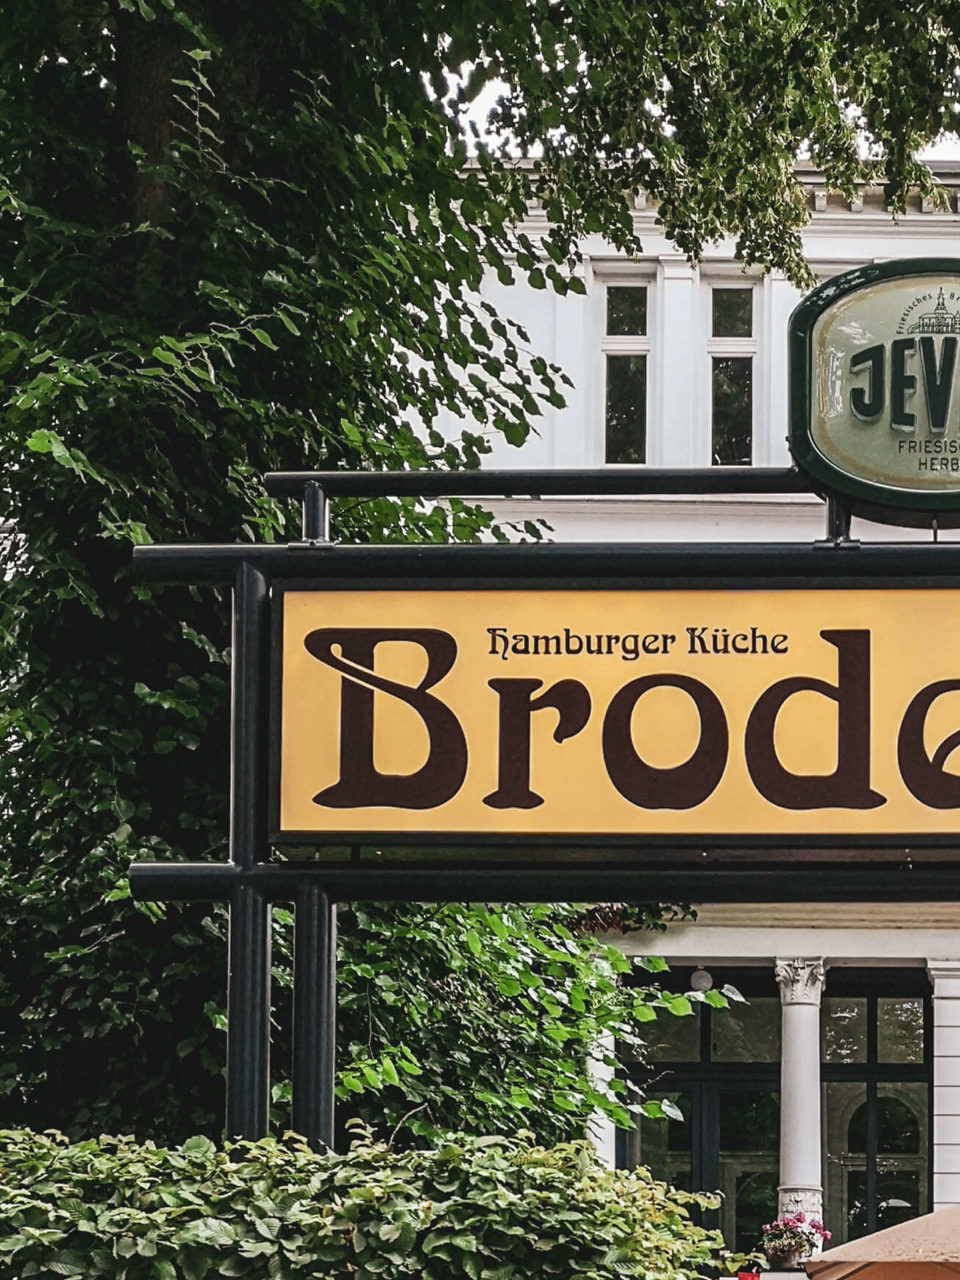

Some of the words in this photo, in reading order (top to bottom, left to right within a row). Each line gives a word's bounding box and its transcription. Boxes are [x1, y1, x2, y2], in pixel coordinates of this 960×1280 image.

[896, 293, 933, 335] Friesisches
[918, 457, 960, 471] HERB
[487, 627, 677, 661] Hamburger
[686, 626, 789, 656] Küche
